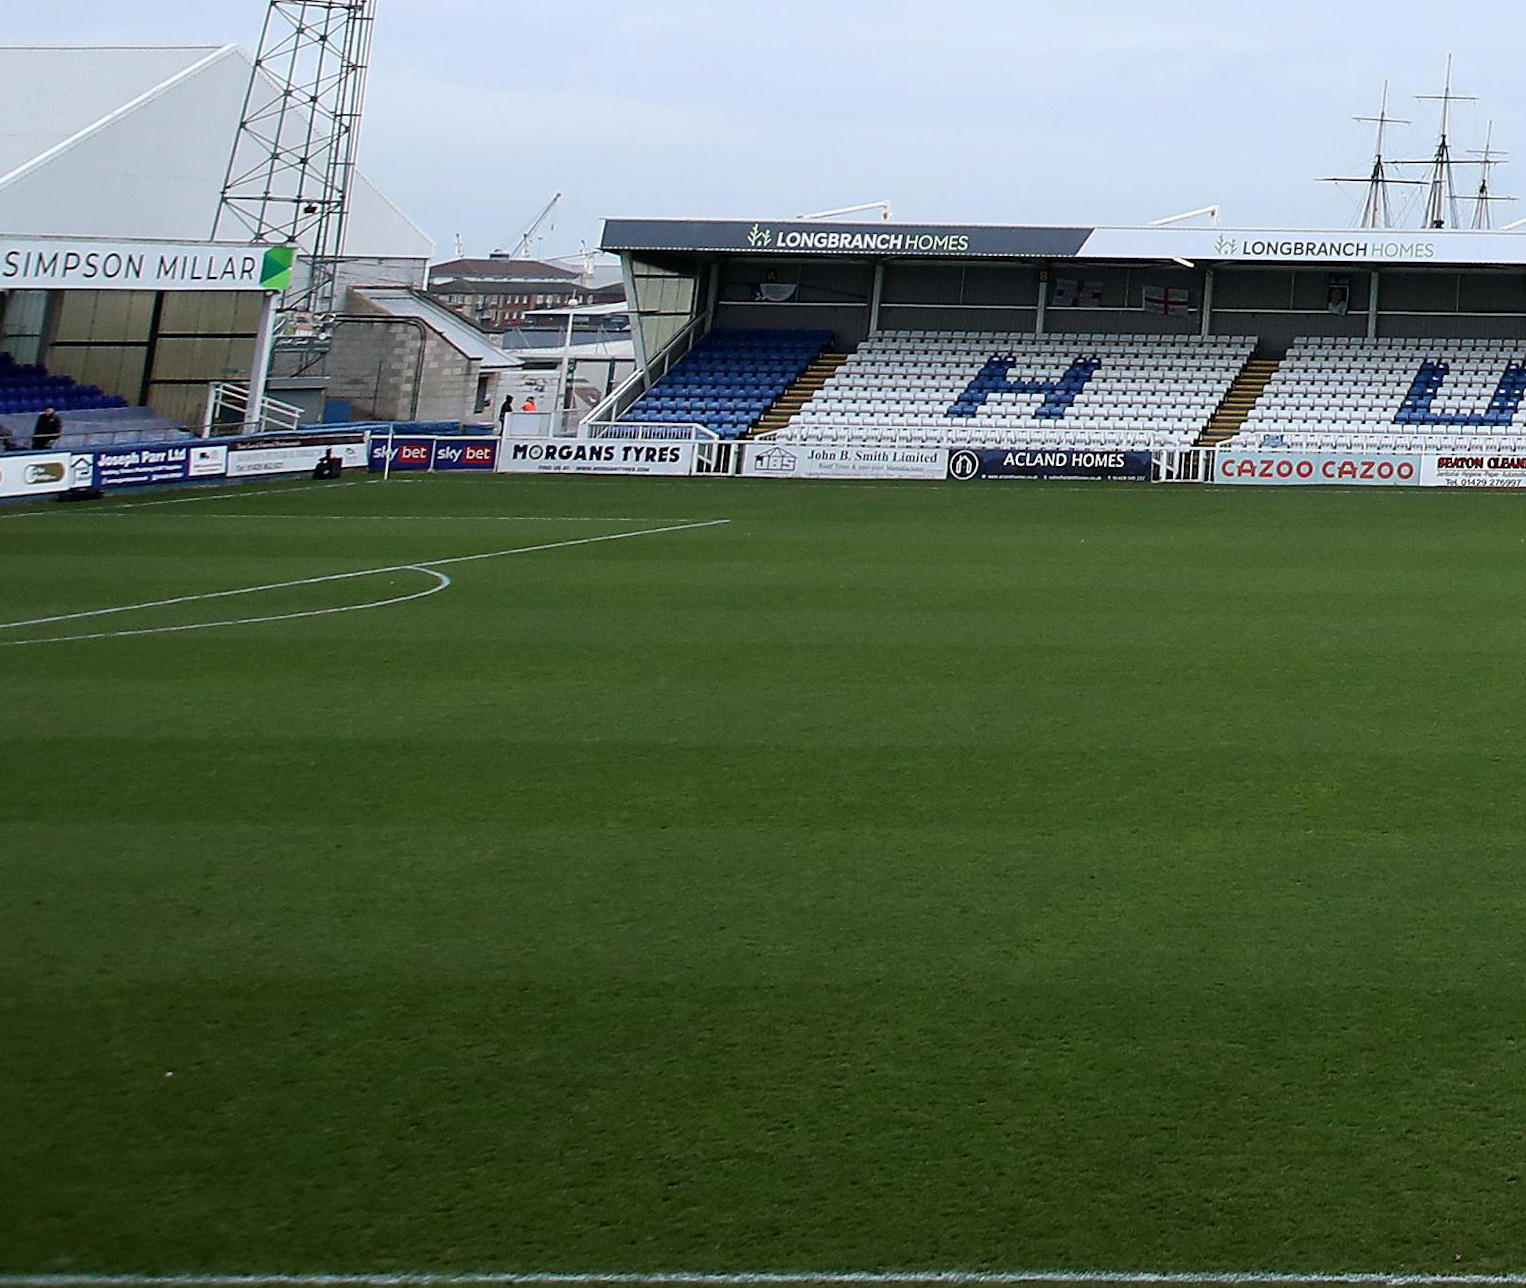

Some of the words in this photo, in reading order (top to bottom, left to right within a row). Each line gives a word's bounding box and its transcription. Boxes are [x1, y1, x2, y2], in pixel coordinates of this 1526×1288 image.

[776, 231, 904, 250] LONGBRANCH
[906, 234, 969, 251] HOMES
[1242, 239, 1368, 256] LONGBRANCH
[1372, 241, 1434, 257] HOMES
[4, 250, 144, 280] SIMPSON
[156, 255, 256, 281] MILLAR
[97, 451, 139, 467] Joseph
[141, 450, 166, 464] Parr
[168, 447, 187, 462] Ltd
[401, 446, 427, 459] bet
[437, 446, 463, 462] sky
[465, 447, 491, 460] bet
[512, 444, 615, 461] MORGANS
[622, 446, 680, 463] TYRES
[807, 450, 835, 460] John
[840, 450, 851, 461] B.
[854, 451, 889, 462] Smith
[893, 451, 937, 463] Limited
[1002, 452, 1067, 467] ACLAND
[1071, 453, 1125, 468] HOMES
[756, 456, 796, 470] JBS
[1221, 459, 1314, 478] CAZOO
[1321, 460, 1414, 479] CAZOO
[1437, 457, 1483, 469] SEATON
